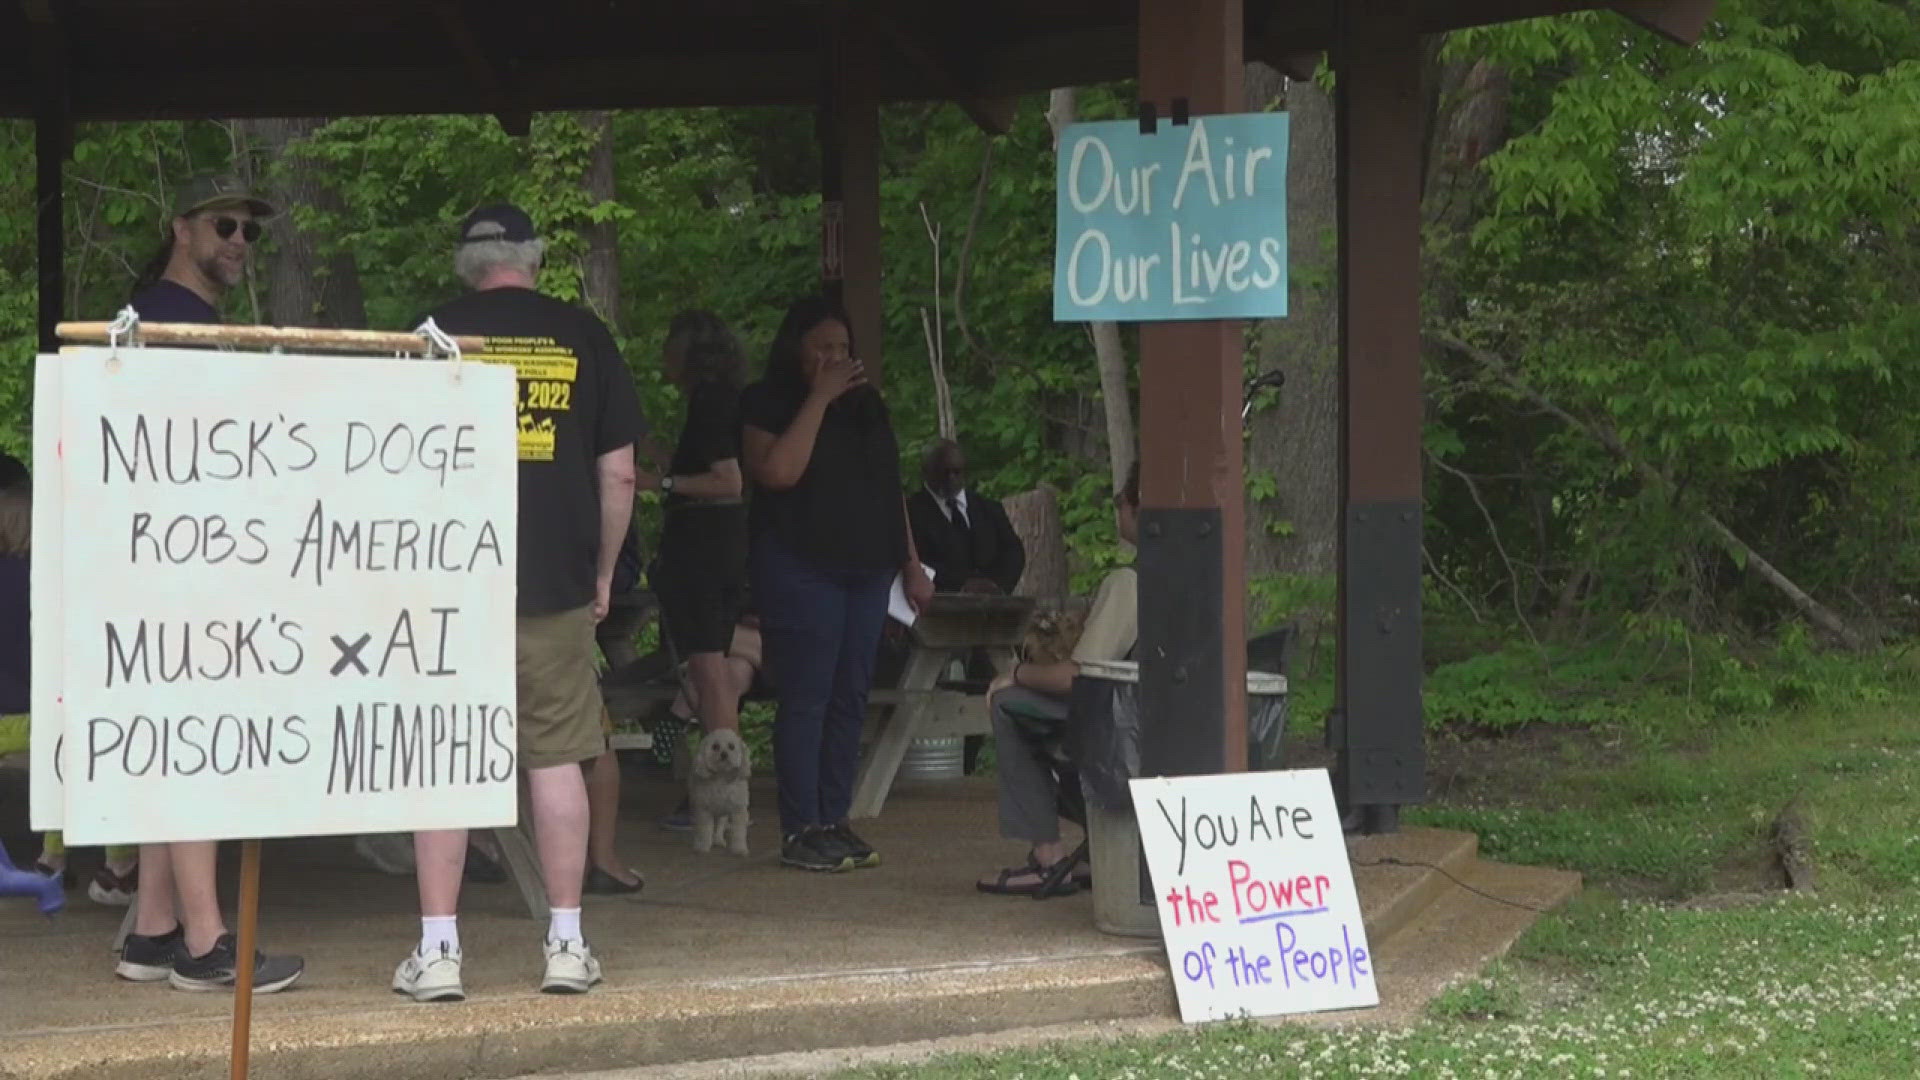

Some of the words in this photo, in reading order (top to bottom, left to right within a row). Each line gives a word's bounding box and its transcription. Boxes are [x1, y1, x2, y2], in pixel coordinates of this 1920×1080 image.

[1068, 136, 1161, 216] Our
[1172, 118, 1273, 210] Air
[1067, 228, 1161, 307] Our
[1171, 221, 1281, 305] Lives
[527, 381, 571, 411] 2022
[100, 414, 317, 485] MUSK'S
[344, 422, 476, 488] DOGE
[131, 512, 269, 565] ROBS
[291, 499, 503, 586] AMERICA
[105, 612, 304, 689] MUSK'S
[87, 713, 312, 782] POISONS
[327, 702, 515, 795] MEMPHIS
[1155, 795, 1239, 876] You
[1250, 794, 1314, 842] Are
[1166, 884, 1221, 927] the
[1227, 859, 1331, 917] Power
[1183, 941, 1217, 990] of
[1225, 945, 1272, 987] the
[1275, 922, 1369, 990] People
